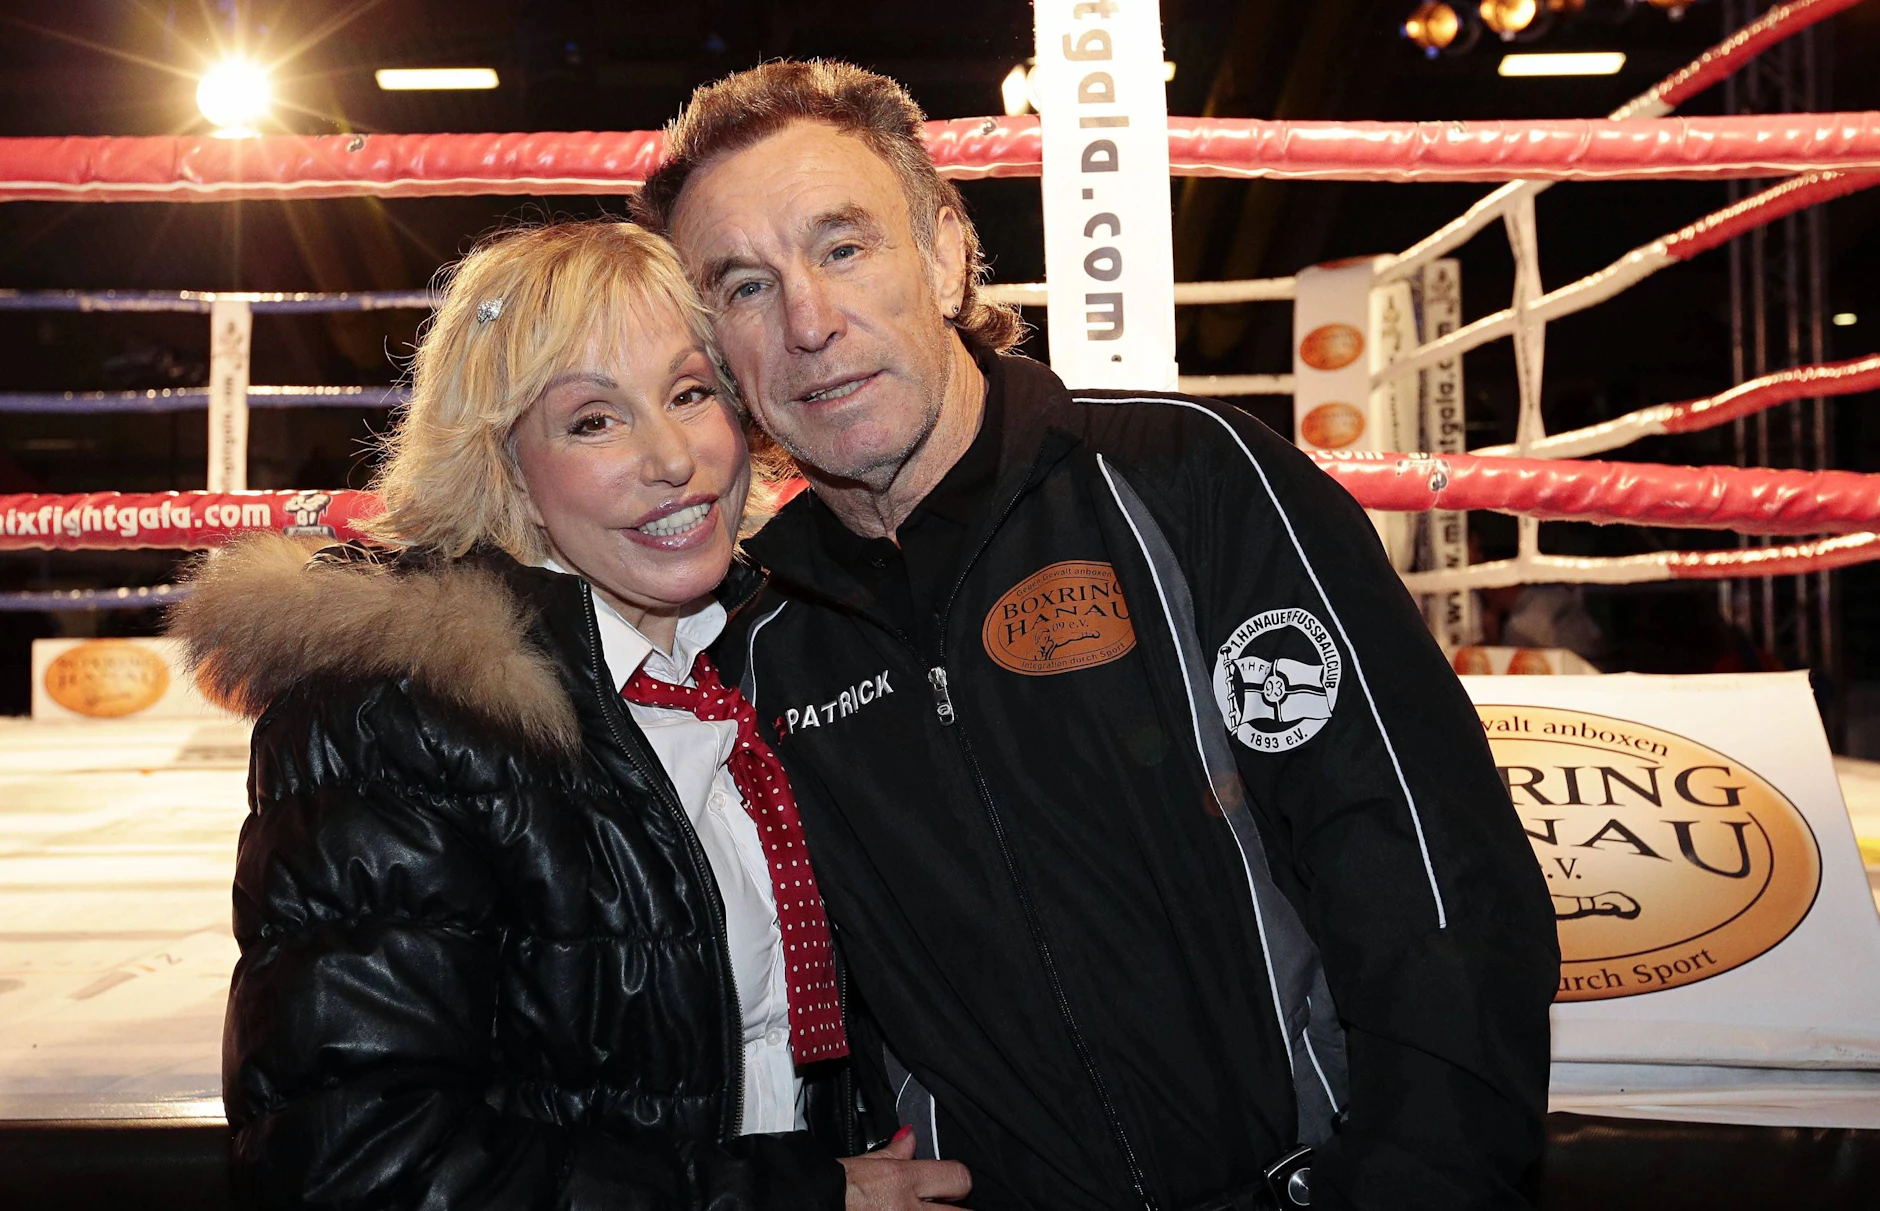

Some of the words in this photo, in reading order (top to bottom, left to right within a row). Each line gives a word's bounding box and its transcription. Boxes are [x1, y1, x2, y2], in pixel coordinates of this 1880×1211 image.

[1016, 578, 1041, 597] Gegen
[1042, 568, 1072, 581] Gewalt
[1075, 568, 1112, 578] anboxen
[1069, 619, 1089, 630] e.V.
[1021, 660, 1068, 671] Integration
[1070, 653, 1098, 665] durch
[1100, 642, 1125, 658] Sport
[1291, 610, 1339, 689] FUSSBALLCLUB
[785, 669, 895, 735] PATRICK
[1265, 680, 1283, 697] 93
[1250, 732, 1279, 749] 1893
[1285, 728, 1308, 746] e.V.
[1543, 722, 1669, 757] anboxen
[1496, 765, 1747, 808] RING
[1541, 857, 1582, 880] .V.
[1632, 948, 1717, 984] Sport
